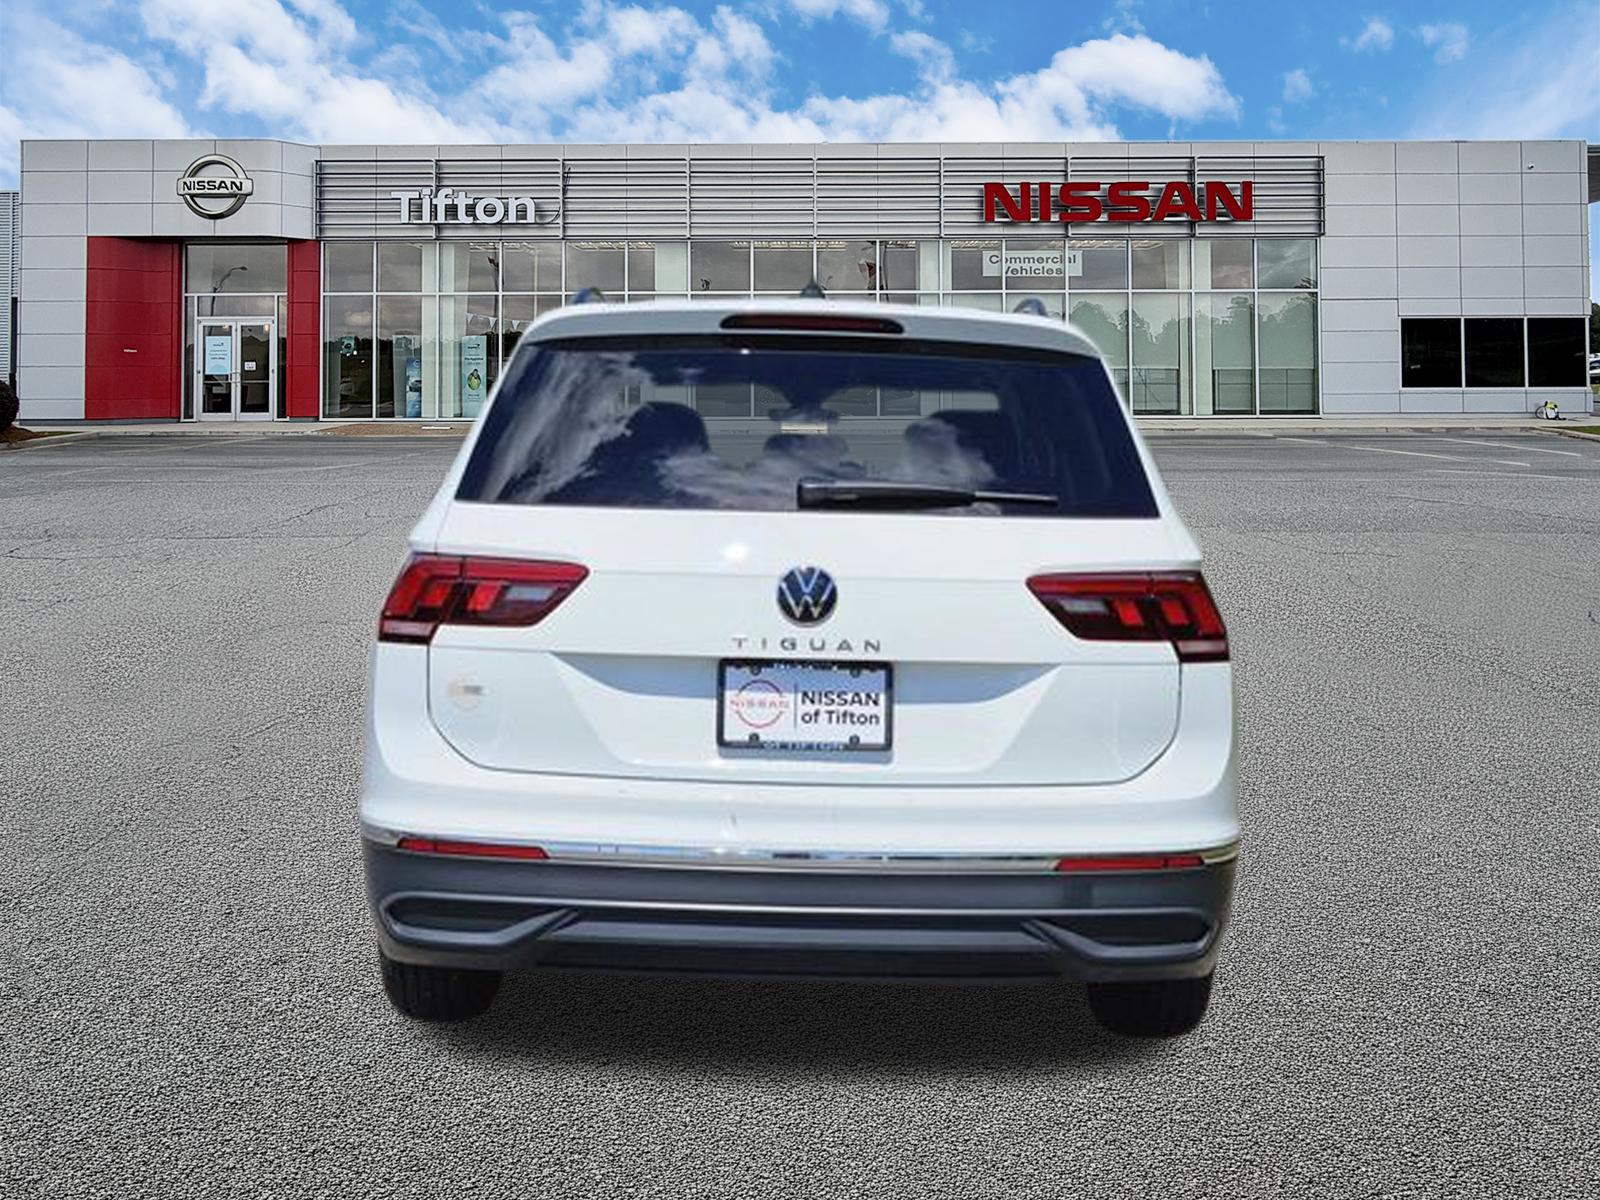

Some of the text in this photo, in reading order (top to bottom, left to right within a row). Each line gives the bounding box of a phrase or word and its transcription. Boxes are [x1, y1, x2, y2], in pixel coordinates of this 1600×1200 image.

[183, 181, 243, 191] NISSAN
[391, 188, 536, 224] Tifton
[984, 181, 1253, 221] NISSAN
[732, 638, 881, 653] TIGUAN
[801, 691, 880, 707] NISSAN
[801, 711, 880, 726] of Tifton
